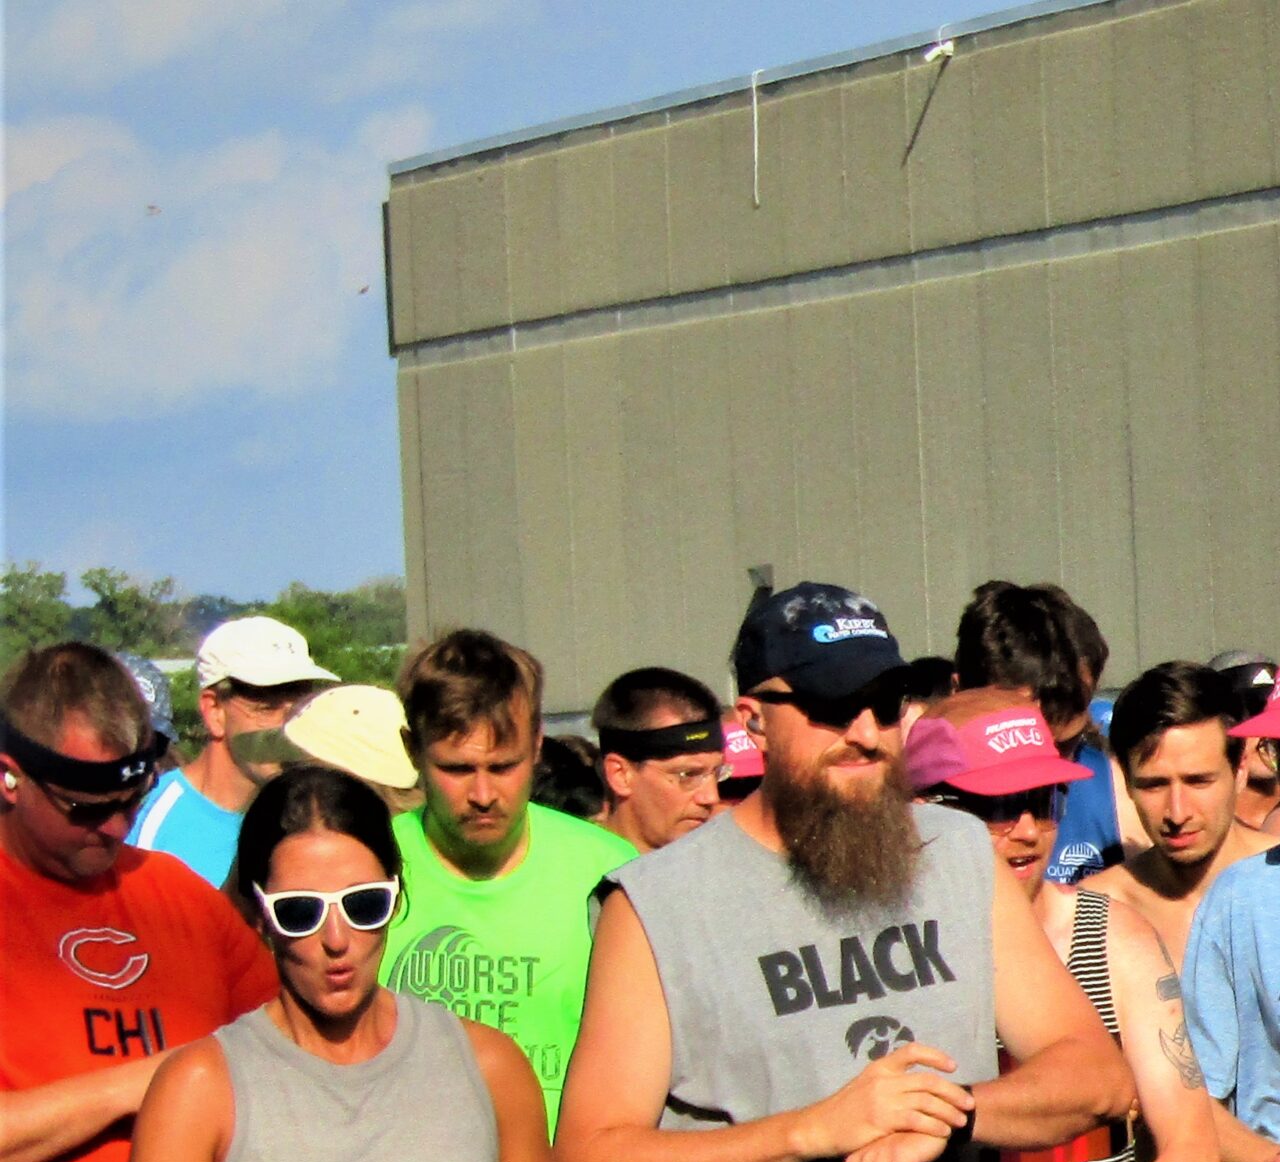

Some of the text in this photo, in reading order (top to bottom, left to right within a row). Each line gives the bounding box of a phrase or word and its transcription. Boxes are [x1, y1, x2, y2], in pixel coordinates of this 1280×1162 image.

[987, 728, 1045, 754] WILD
[408, 952, 541, 998] WORST
[757, 919, 957, 1016] BLACK
[83, 1007, 167, 1056] CHI
